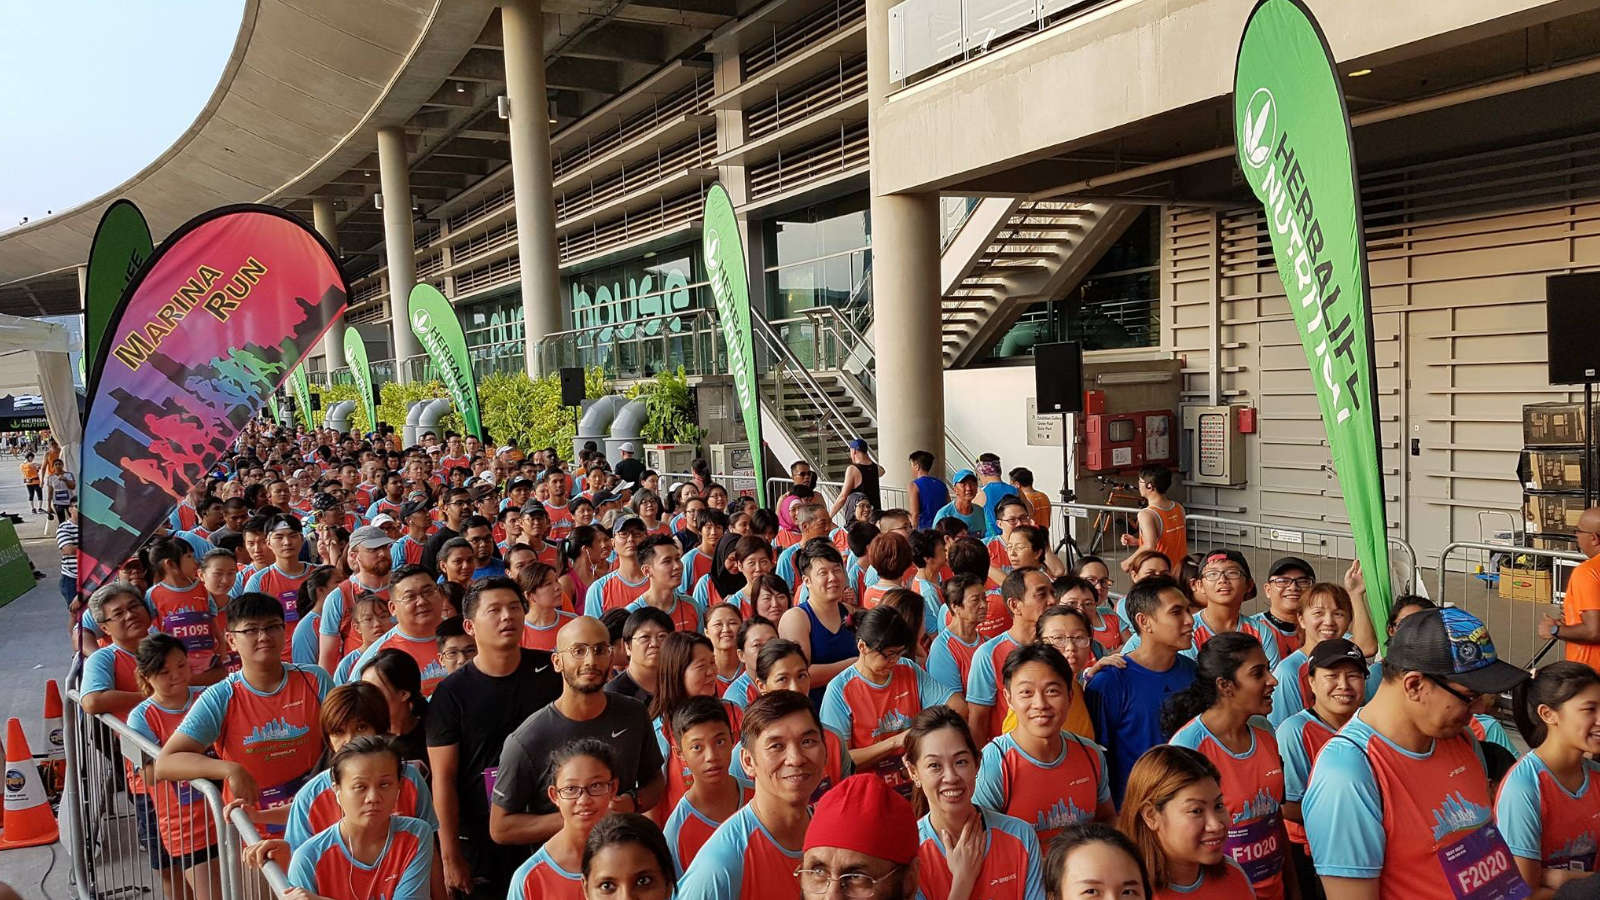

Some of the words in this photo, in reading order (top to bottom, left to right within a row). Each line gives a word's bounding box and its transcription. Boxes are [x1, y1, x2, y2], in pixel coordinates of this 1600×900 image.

[112, 264, 225, 372] MARINA
[203, 256, 268, 323] RUN
[572, 268, 690, 346] house
[430, 326, 474, 409] HERBALIFE
[173, 624, 209, 637] F1095
[1232, 836, 1277, 862] F1020
[1457, 850, 1507, 894] F2020
